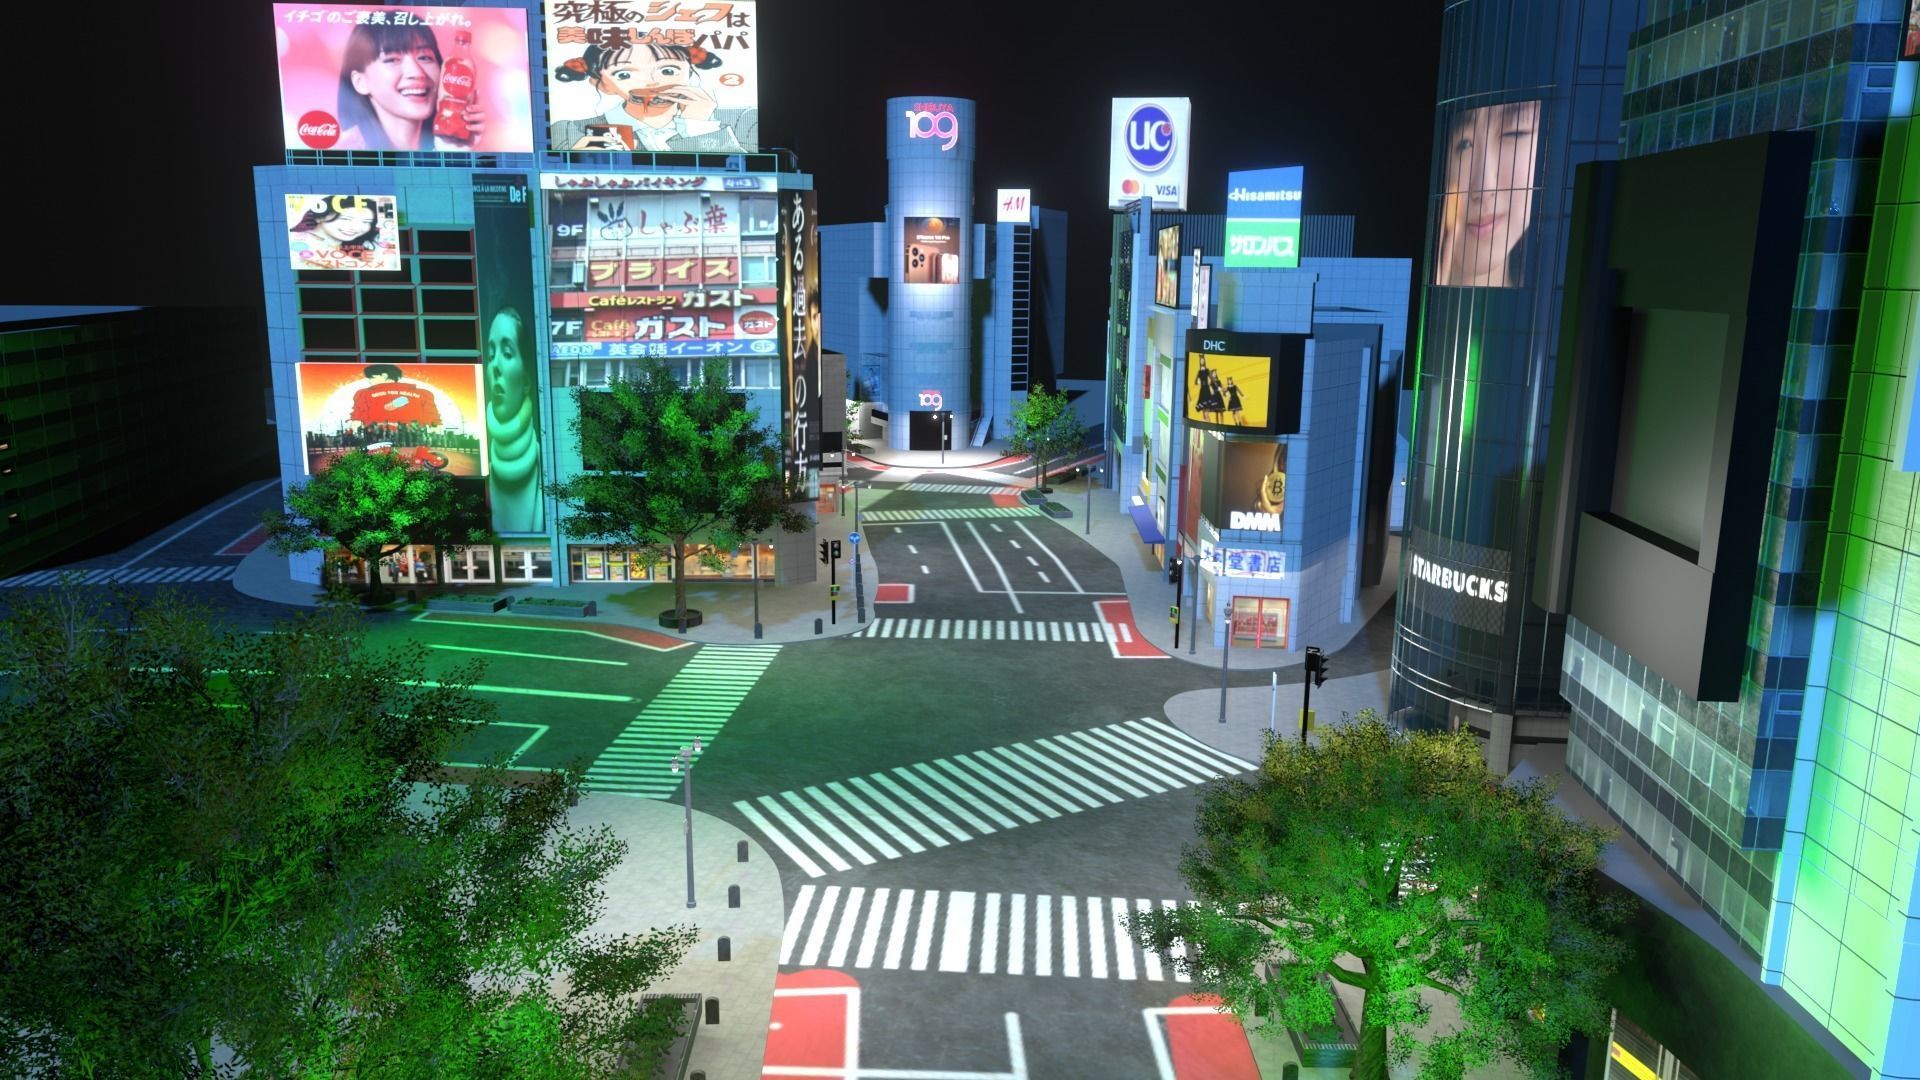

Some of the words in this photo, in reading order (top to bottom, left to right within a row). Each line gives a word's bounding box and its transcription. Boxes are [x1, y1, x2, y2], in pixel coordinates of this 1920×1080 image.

[284, 10, 472, 28] イチゴのご褒美、召し上がれ。
[557, 27, 750, 50] 美味しんぼパパ
[299, 123, 338, 138] Coca-Cola
[905, 110, 959, 152] 109
[1130, 120, 1171, 152] UC
[555, 176, 706, 188] しゃぶしゃぶバイキング
[1155, 185, 1178, 196] VISA
[1228, 188, 1302, 202] Hisamitsu
[639, 203, 729, 235] しゃぶ葉
[556, 223, 584, 238] 9F
[682, 289, 755, 308] ガスト
[551, 320, 583, 336] 7F
[635, 315, 726, 339] ガスト
[608, 342, 743, 355] 英会話イーオン
[1203, 339, 1226, 351] DHC
[918, 393, 943, 412] 109
[1230, 511, 1281, 532] DMM
